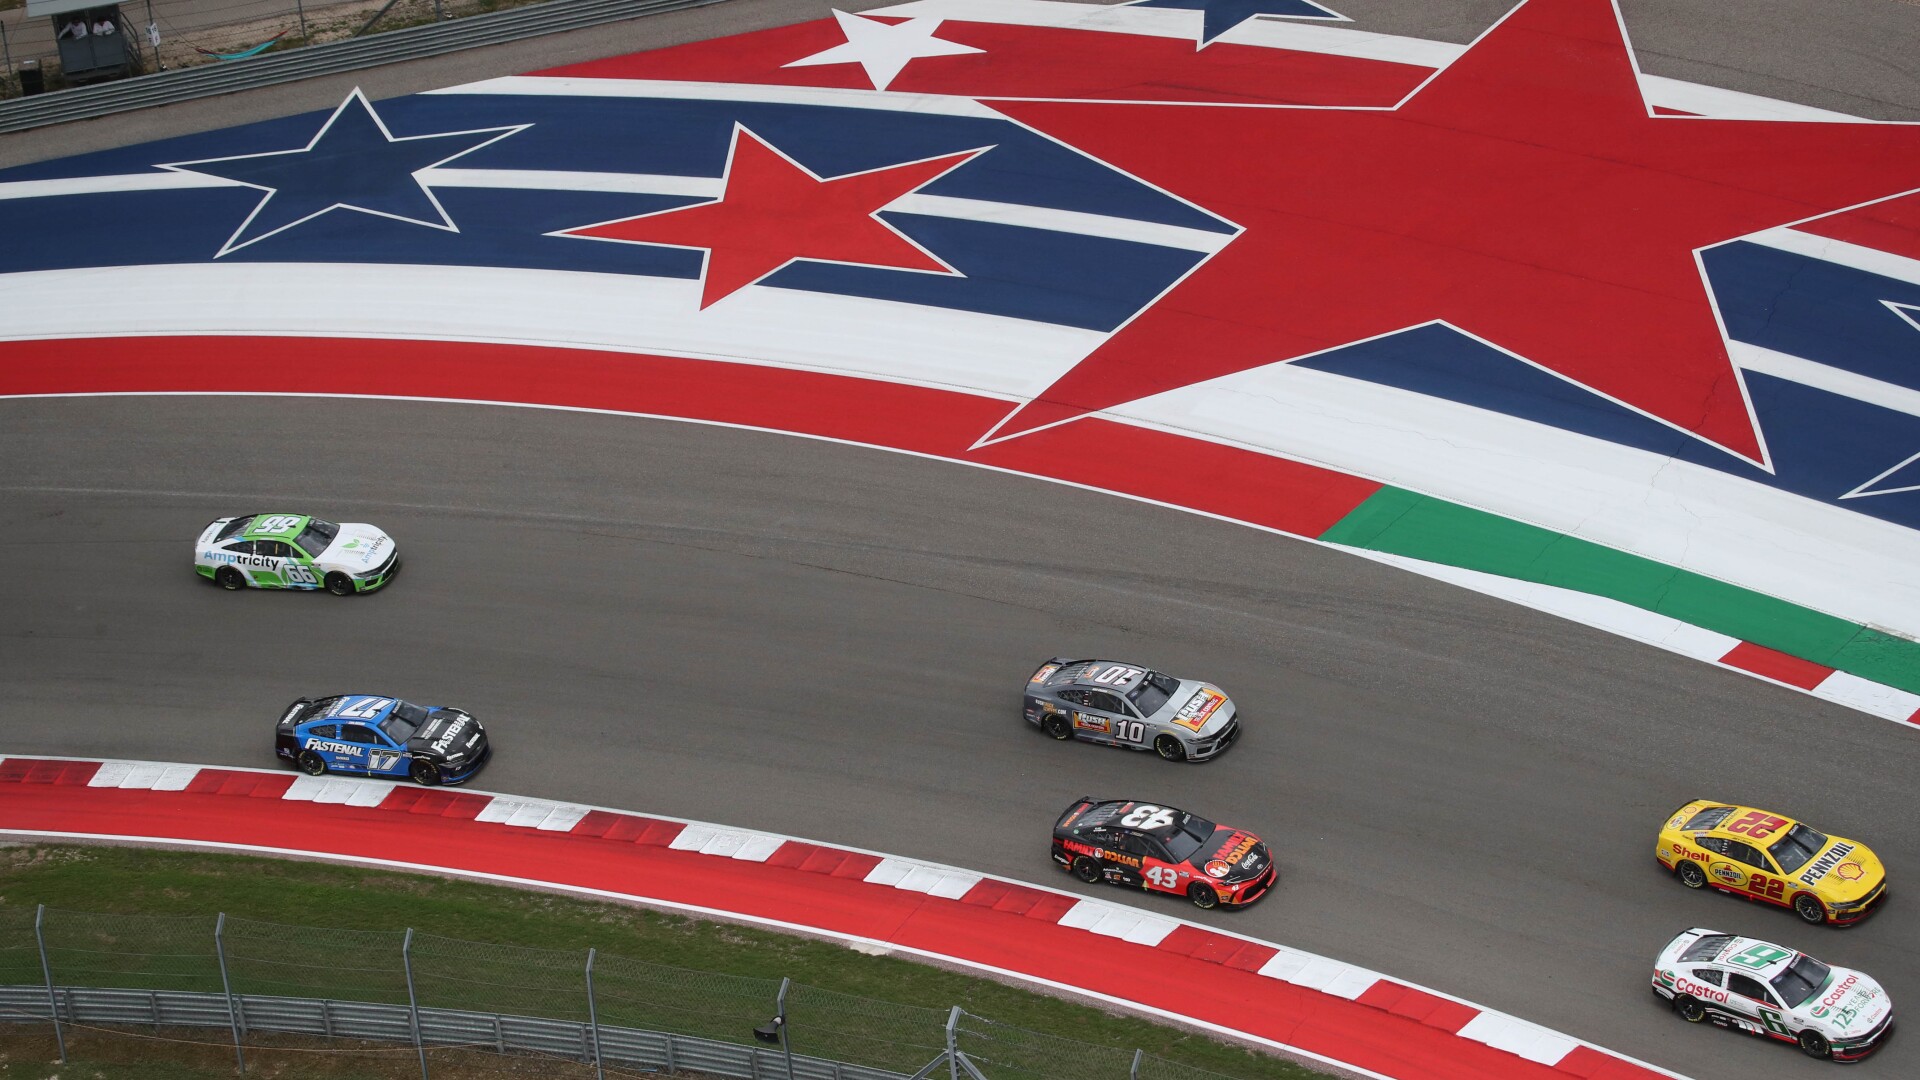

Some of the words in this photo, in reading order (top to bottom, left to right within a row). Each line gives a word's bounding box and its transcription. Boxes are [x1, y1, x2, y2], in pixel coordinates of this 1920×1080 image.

[204, 550, 280, 571] Amptricity
[284, 564, 318, 584] 66
[1094, 665, 1144, 686] 10
[431, 713, 470, 754] FASTENAL
[1115, 719, 1144, 743] 10
[304, 737, 363, 757] FASTENAL
[367, 747, 402, 771] 17
[1728, 811, 1788, 839] 22
[1063, 839, 1095, 857] FAMILY
[1104, 850, 1141, 868] DOLLAR
[1225, 836, 1258, 865] DOLLAR
[1672, 843, 1710, 862] Shell
[1715, 868, 1742, 879] PENNZOIL
[1800, 842, 1854, 886] PENNZOIL
[1145, 866, 1178, 889] 43
[1748, 873, 1784, 899] 22
[1676, 977, 1730, 1004] Castrol
[1823, 974, 1859, 1007] Castrol
[1760, 1008, 1790, 1036] 6
[1832, 1006, 1857, 1029] 125
